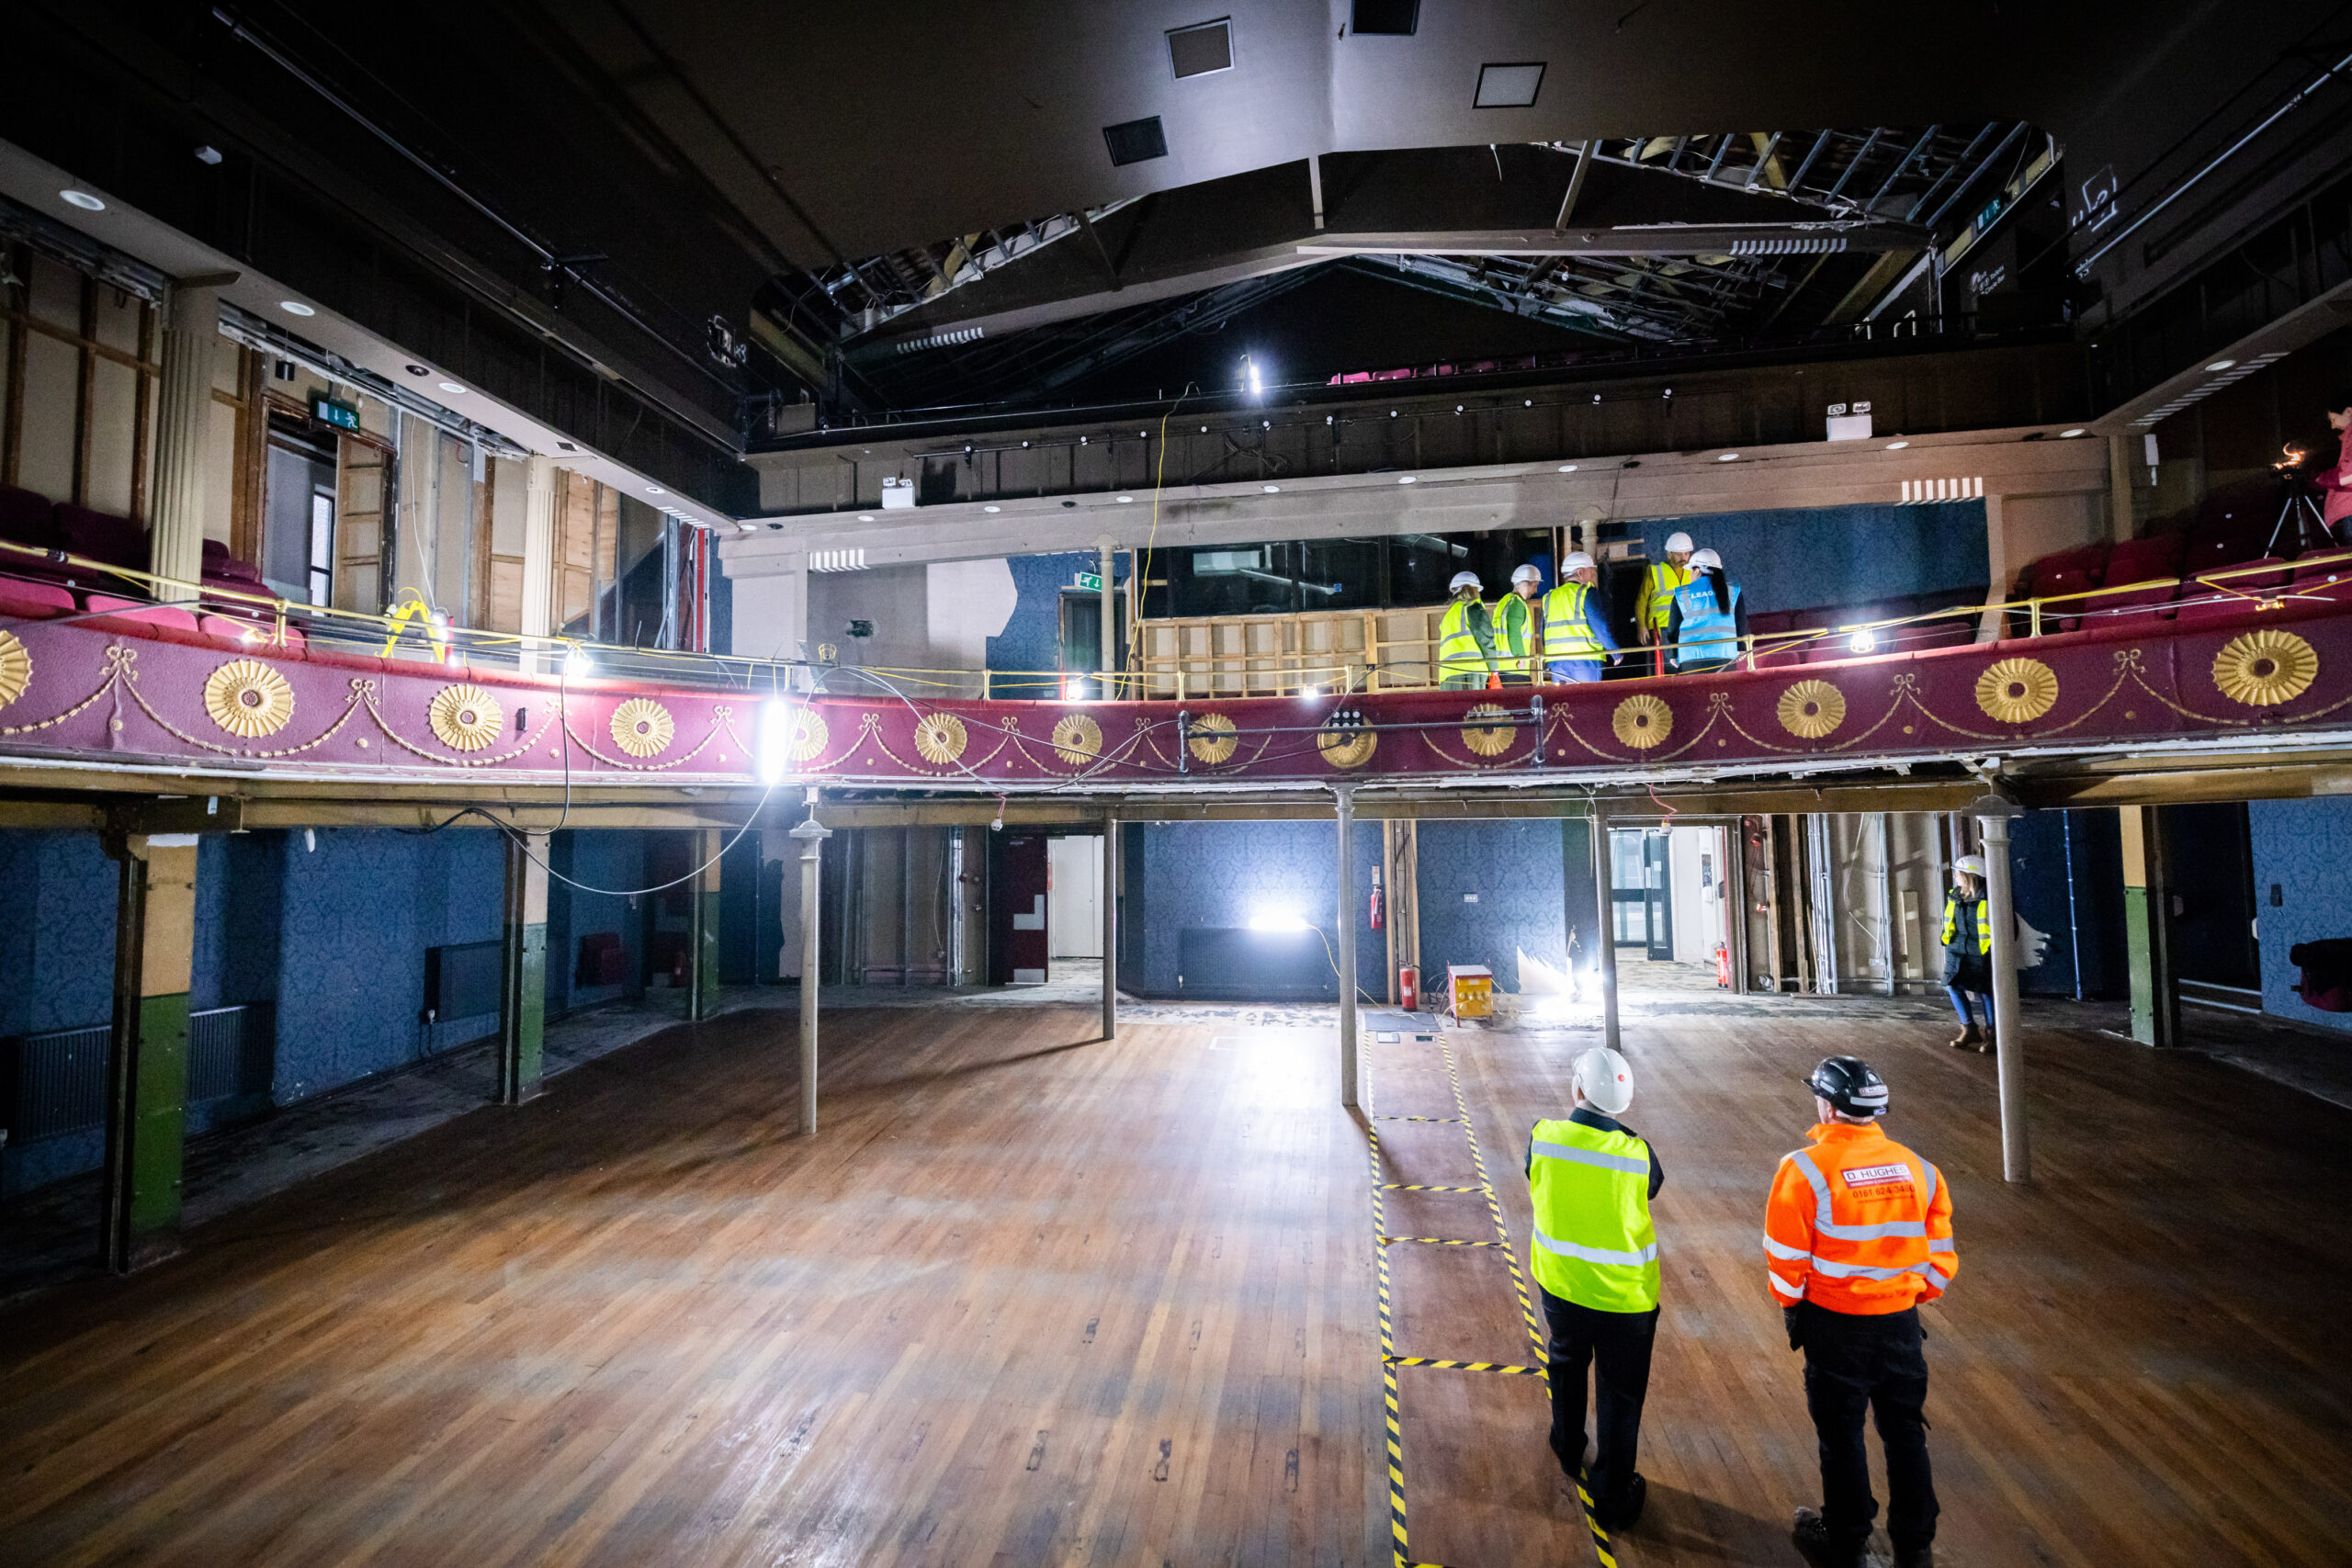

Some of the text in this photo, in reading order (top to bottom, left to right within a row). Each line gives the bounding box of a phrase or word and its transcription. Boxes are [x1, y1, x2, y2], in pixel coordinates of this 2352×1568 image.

[1860, 1166, 1907, 1179] HUGHES
[1852, 1189, 1873, 1199] 0161
[1875, 1186, 1892, 1196] 624
